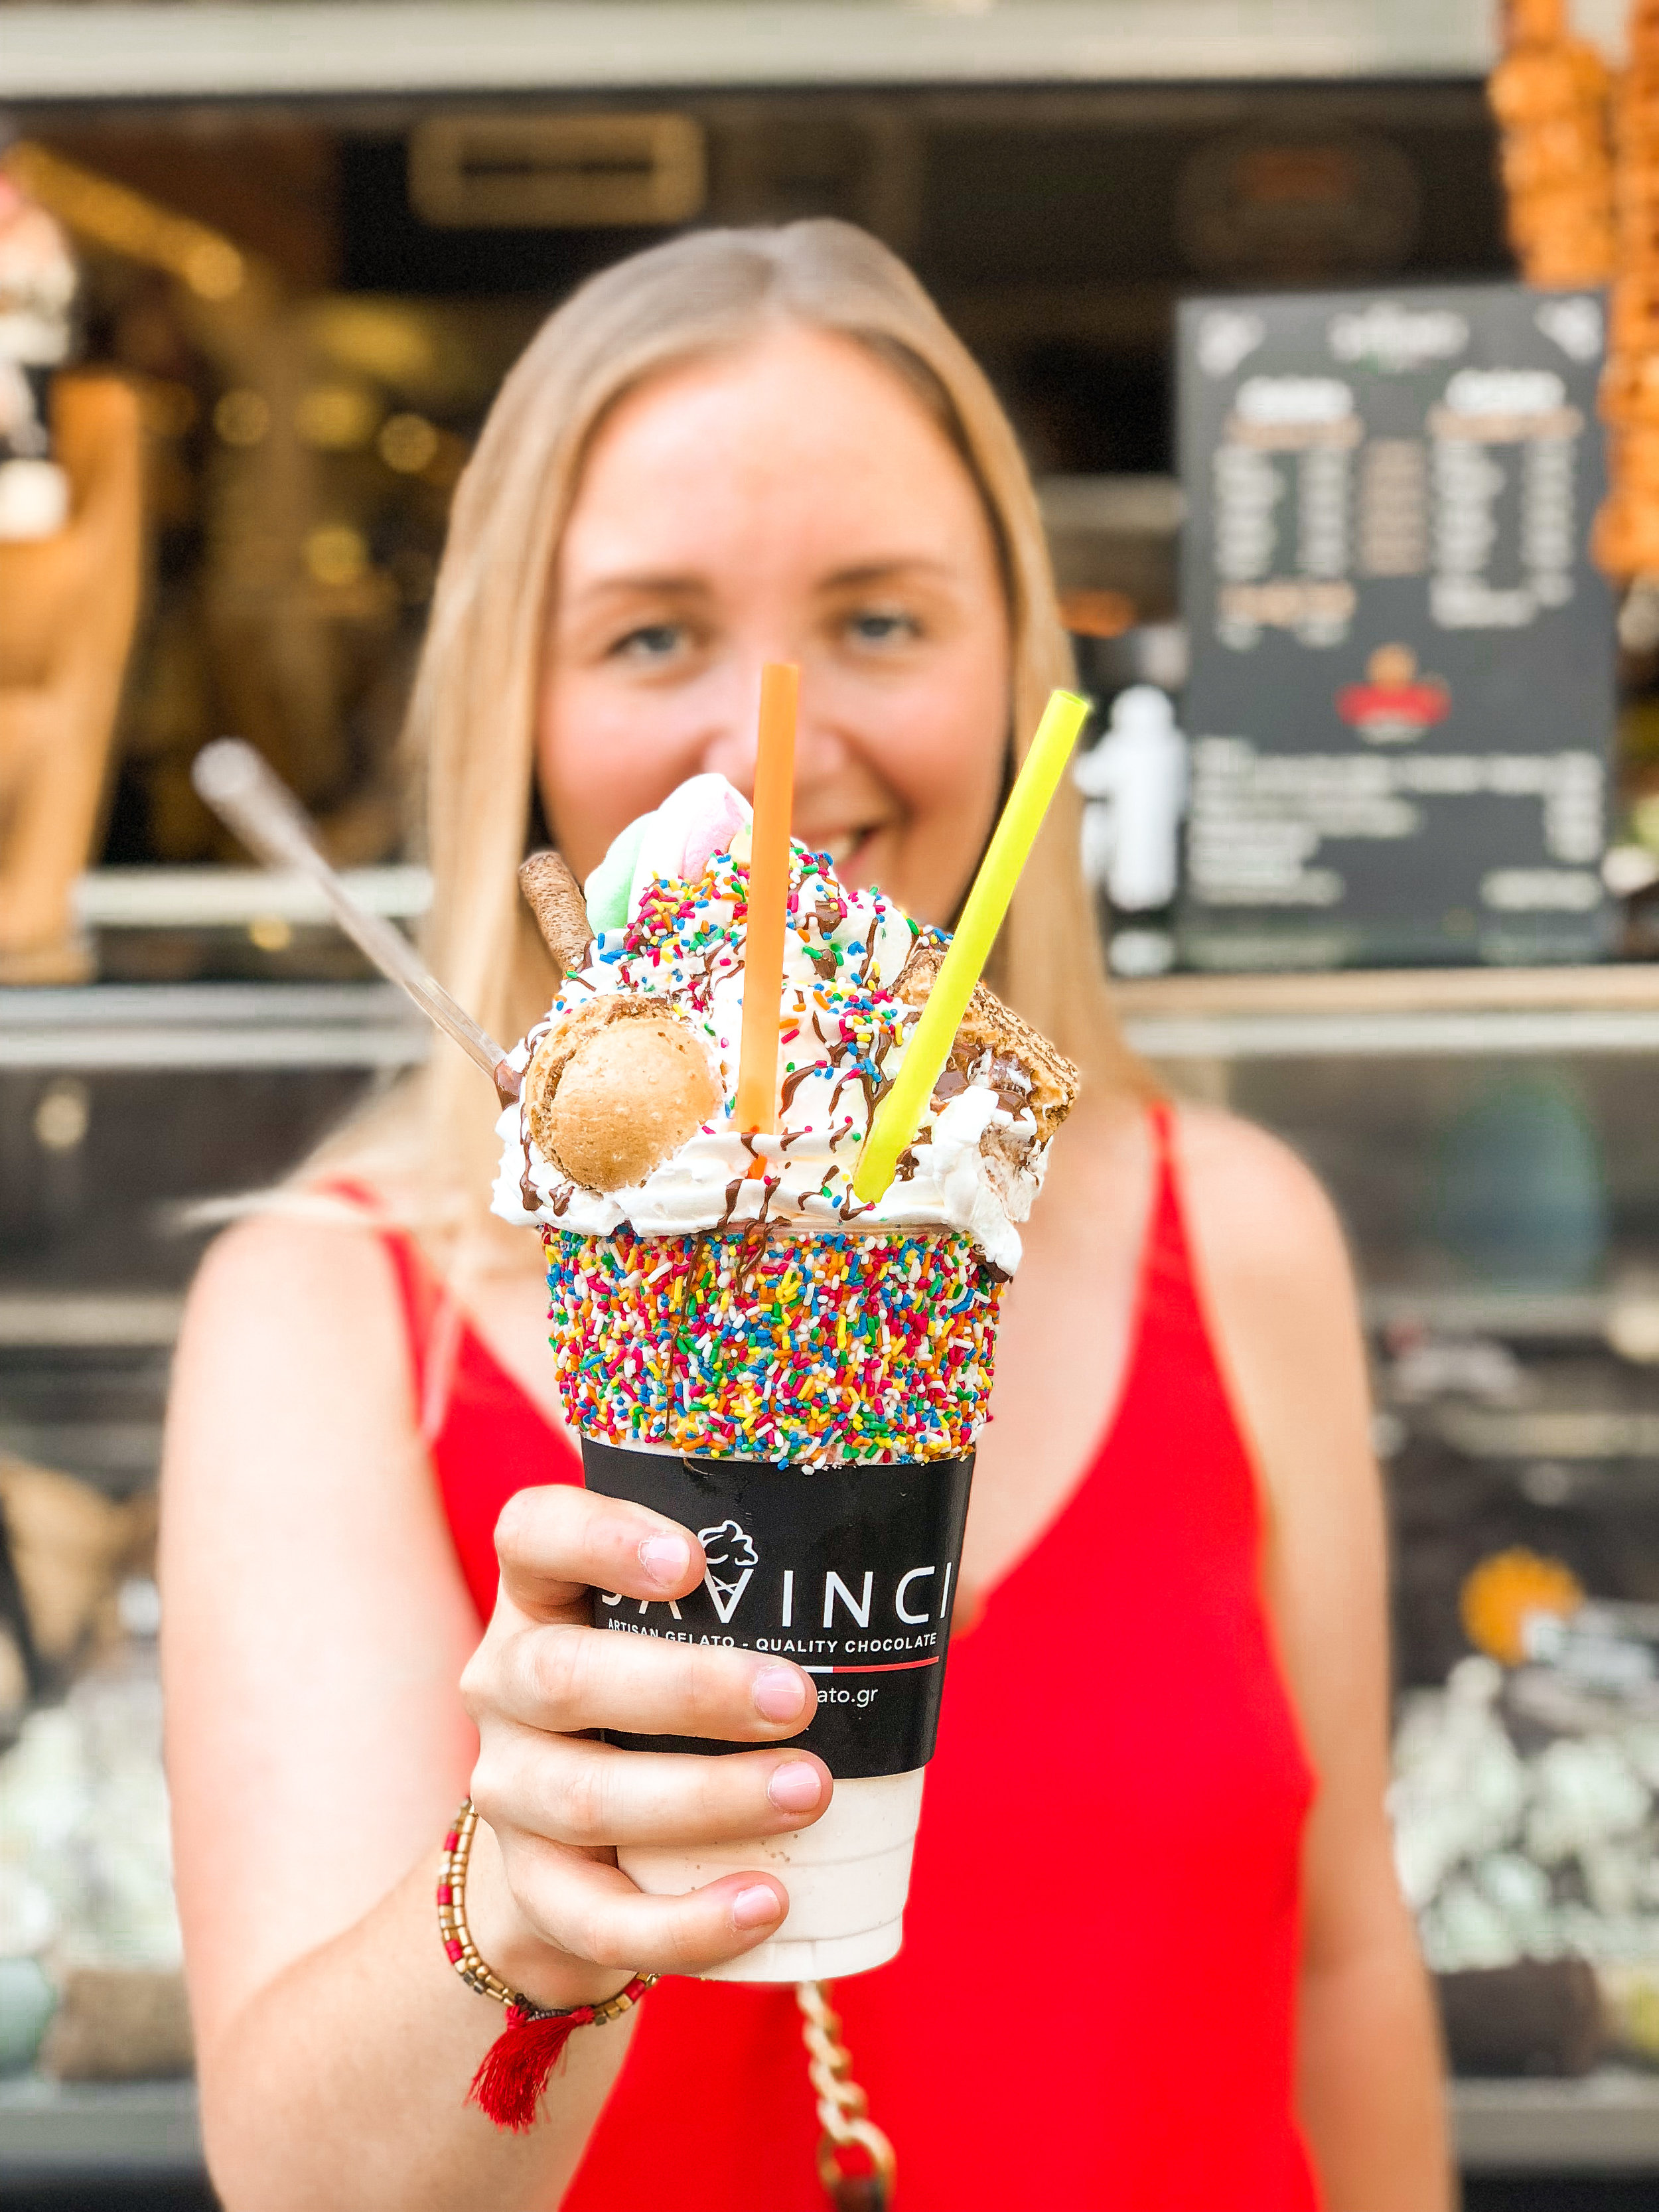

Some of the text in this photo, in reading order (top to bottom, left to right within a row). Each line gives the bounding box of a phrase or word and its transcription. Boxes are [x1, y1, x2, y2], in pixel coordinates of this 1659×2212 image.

[601, 1562, 952, 1628] VINCI
[608, 1617, 659, 1638] ARTISAN
[756, 1638, 838, 1654] QUALITY
[845, 1632, 937, 1653] CHOCOLATE
[817, 1687, 878, 1708] ato.gr
